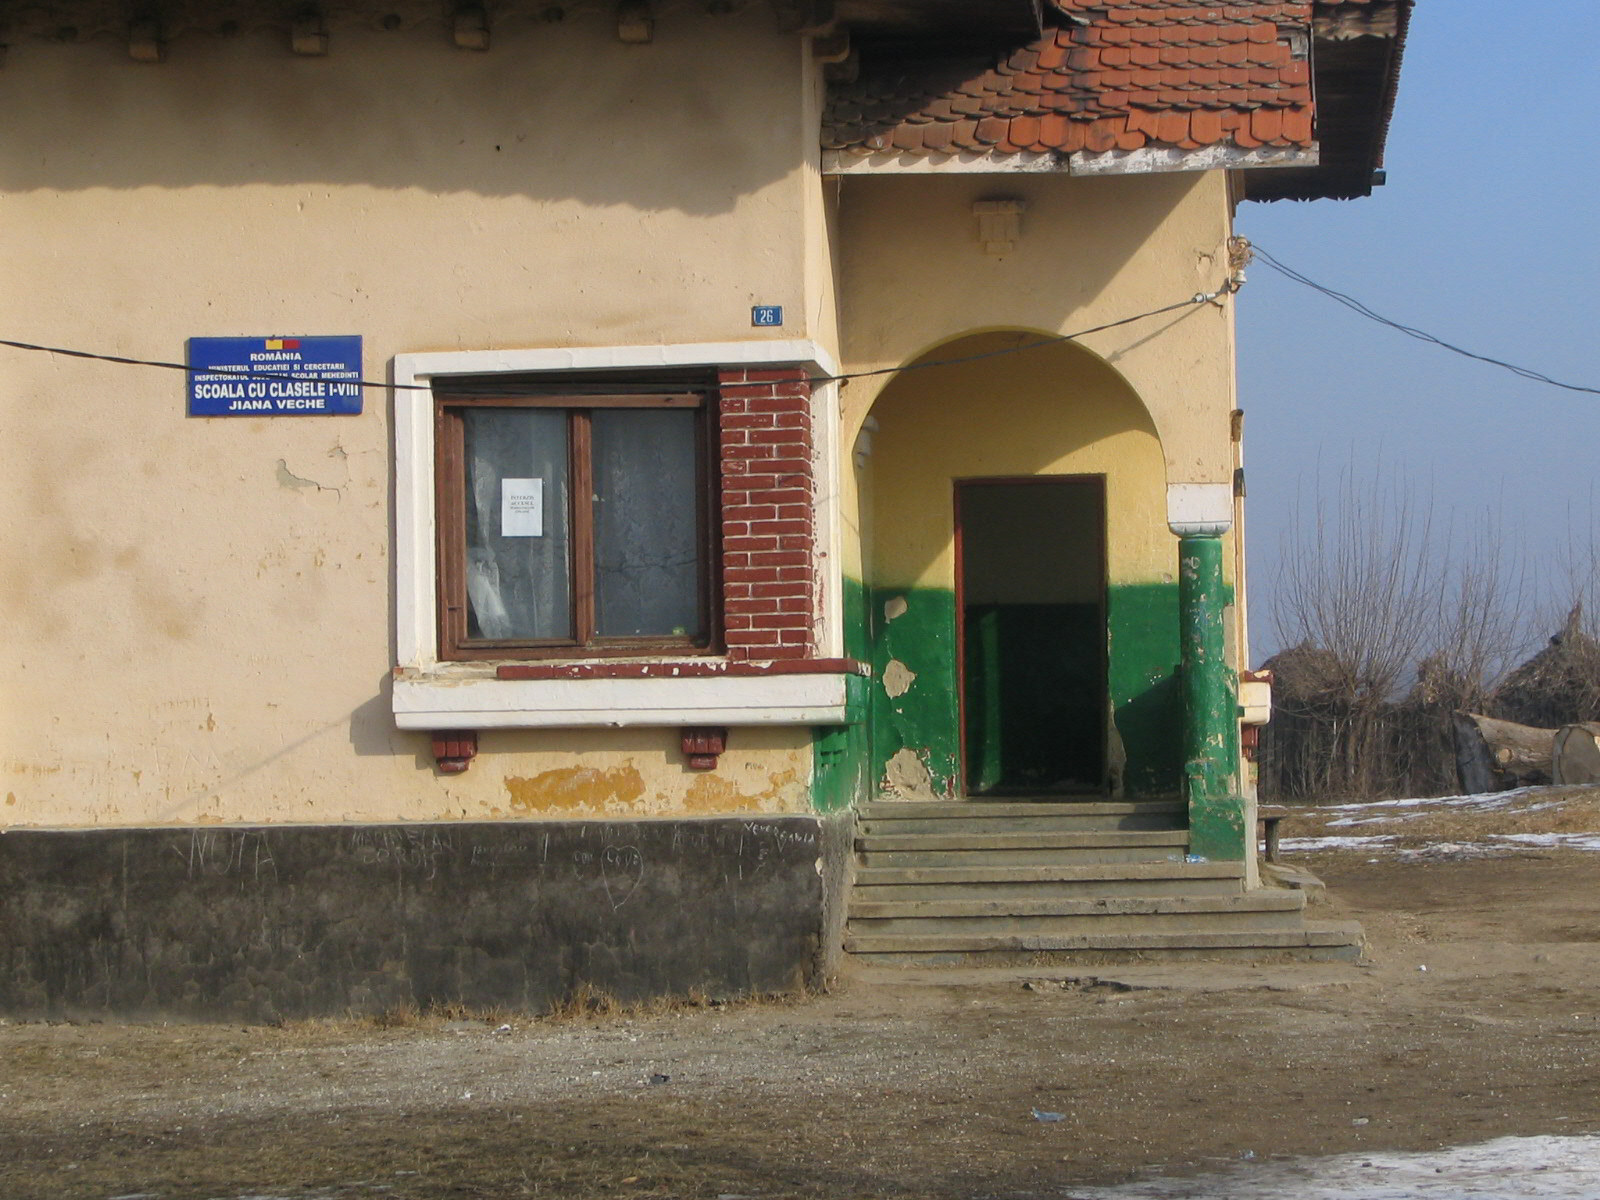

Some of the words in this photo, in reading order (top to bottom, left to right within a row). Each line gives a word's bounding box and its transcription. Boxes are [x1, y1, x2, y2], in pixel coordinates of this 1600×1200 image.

[760, 310, 773, 323] 26
[250, 351, 302, 361] ROMÂNIA
[195, 383, 245, 399] SCOALA
[248, 382, 266, 398] CU
[269, 381, 326, 397] CLASELE
[329, 382, 359, 397] I-VIII
[229, 400, 273, 410] JIANA
[276, 398, 326, 409] VECHE
